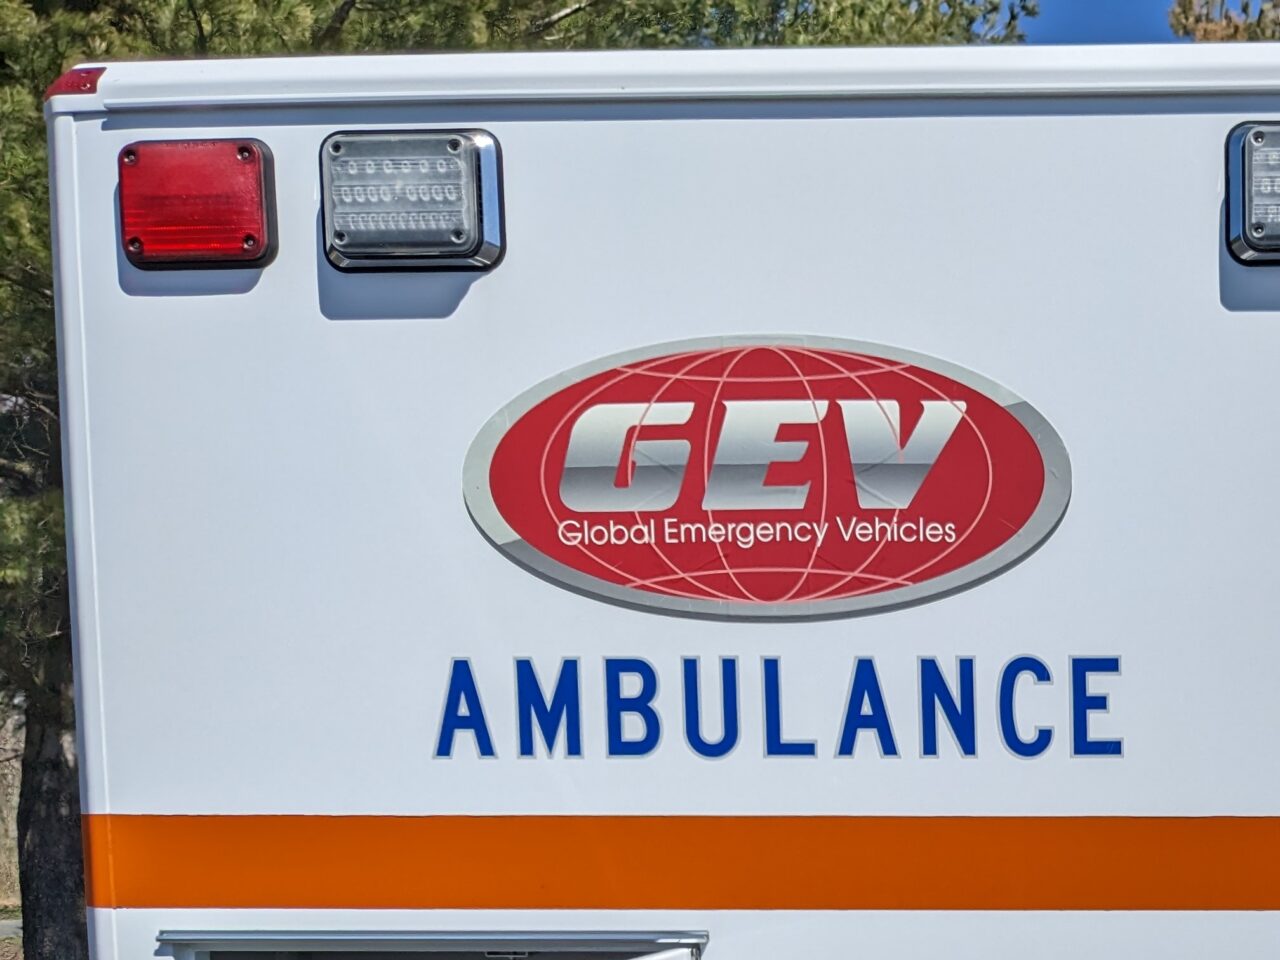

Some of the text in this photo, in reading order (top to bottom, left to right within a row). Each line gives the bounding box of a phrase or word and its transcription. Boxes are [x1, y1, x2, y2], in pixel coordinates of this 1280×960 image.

[558, 399, 968, 513] GEV
[557, 515, 957, 549] Global Emergency Vehicles
[432, 654, 1125, 760] AMBULANCE
